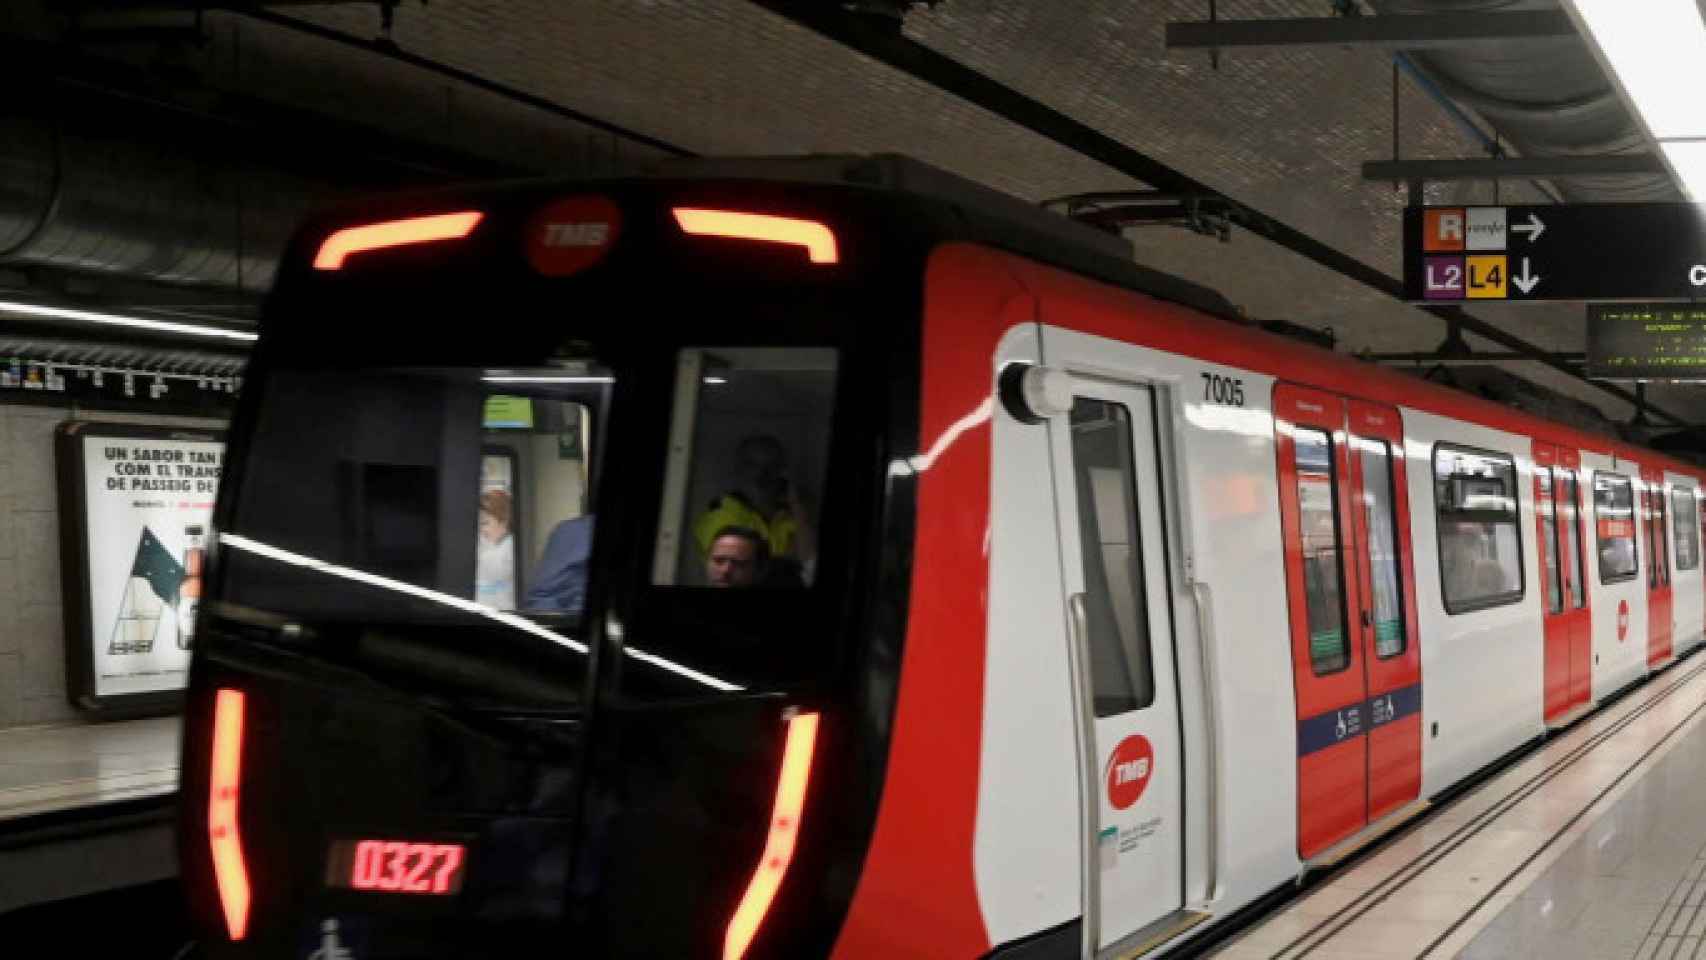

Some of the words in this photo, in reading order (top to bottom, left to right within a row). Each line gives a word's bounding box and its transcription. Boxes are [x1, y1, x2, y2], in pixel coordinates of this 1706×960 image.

[543, 223, 608, 247] TMB
[1438, 214, 1463, 241] R
[1426, 265, 1462, 291] L2
[1469, 265, 1502, 289] L4
[1201, 372, 1244, 407] 7005
[104, 447, 128, 461] UN
[132, 448, 184, 463] SABOR
[189, 451, 216, 464] TAN
[114, 462, 152, 476] COM
[156, 464, 172, 476] EL
[106, 477, 126, 491] DE
[131, 478, 192, 491] PASSEIG
[1115, 756, 1149, 787] TMB
[351, 840, 464, 893] 0327
